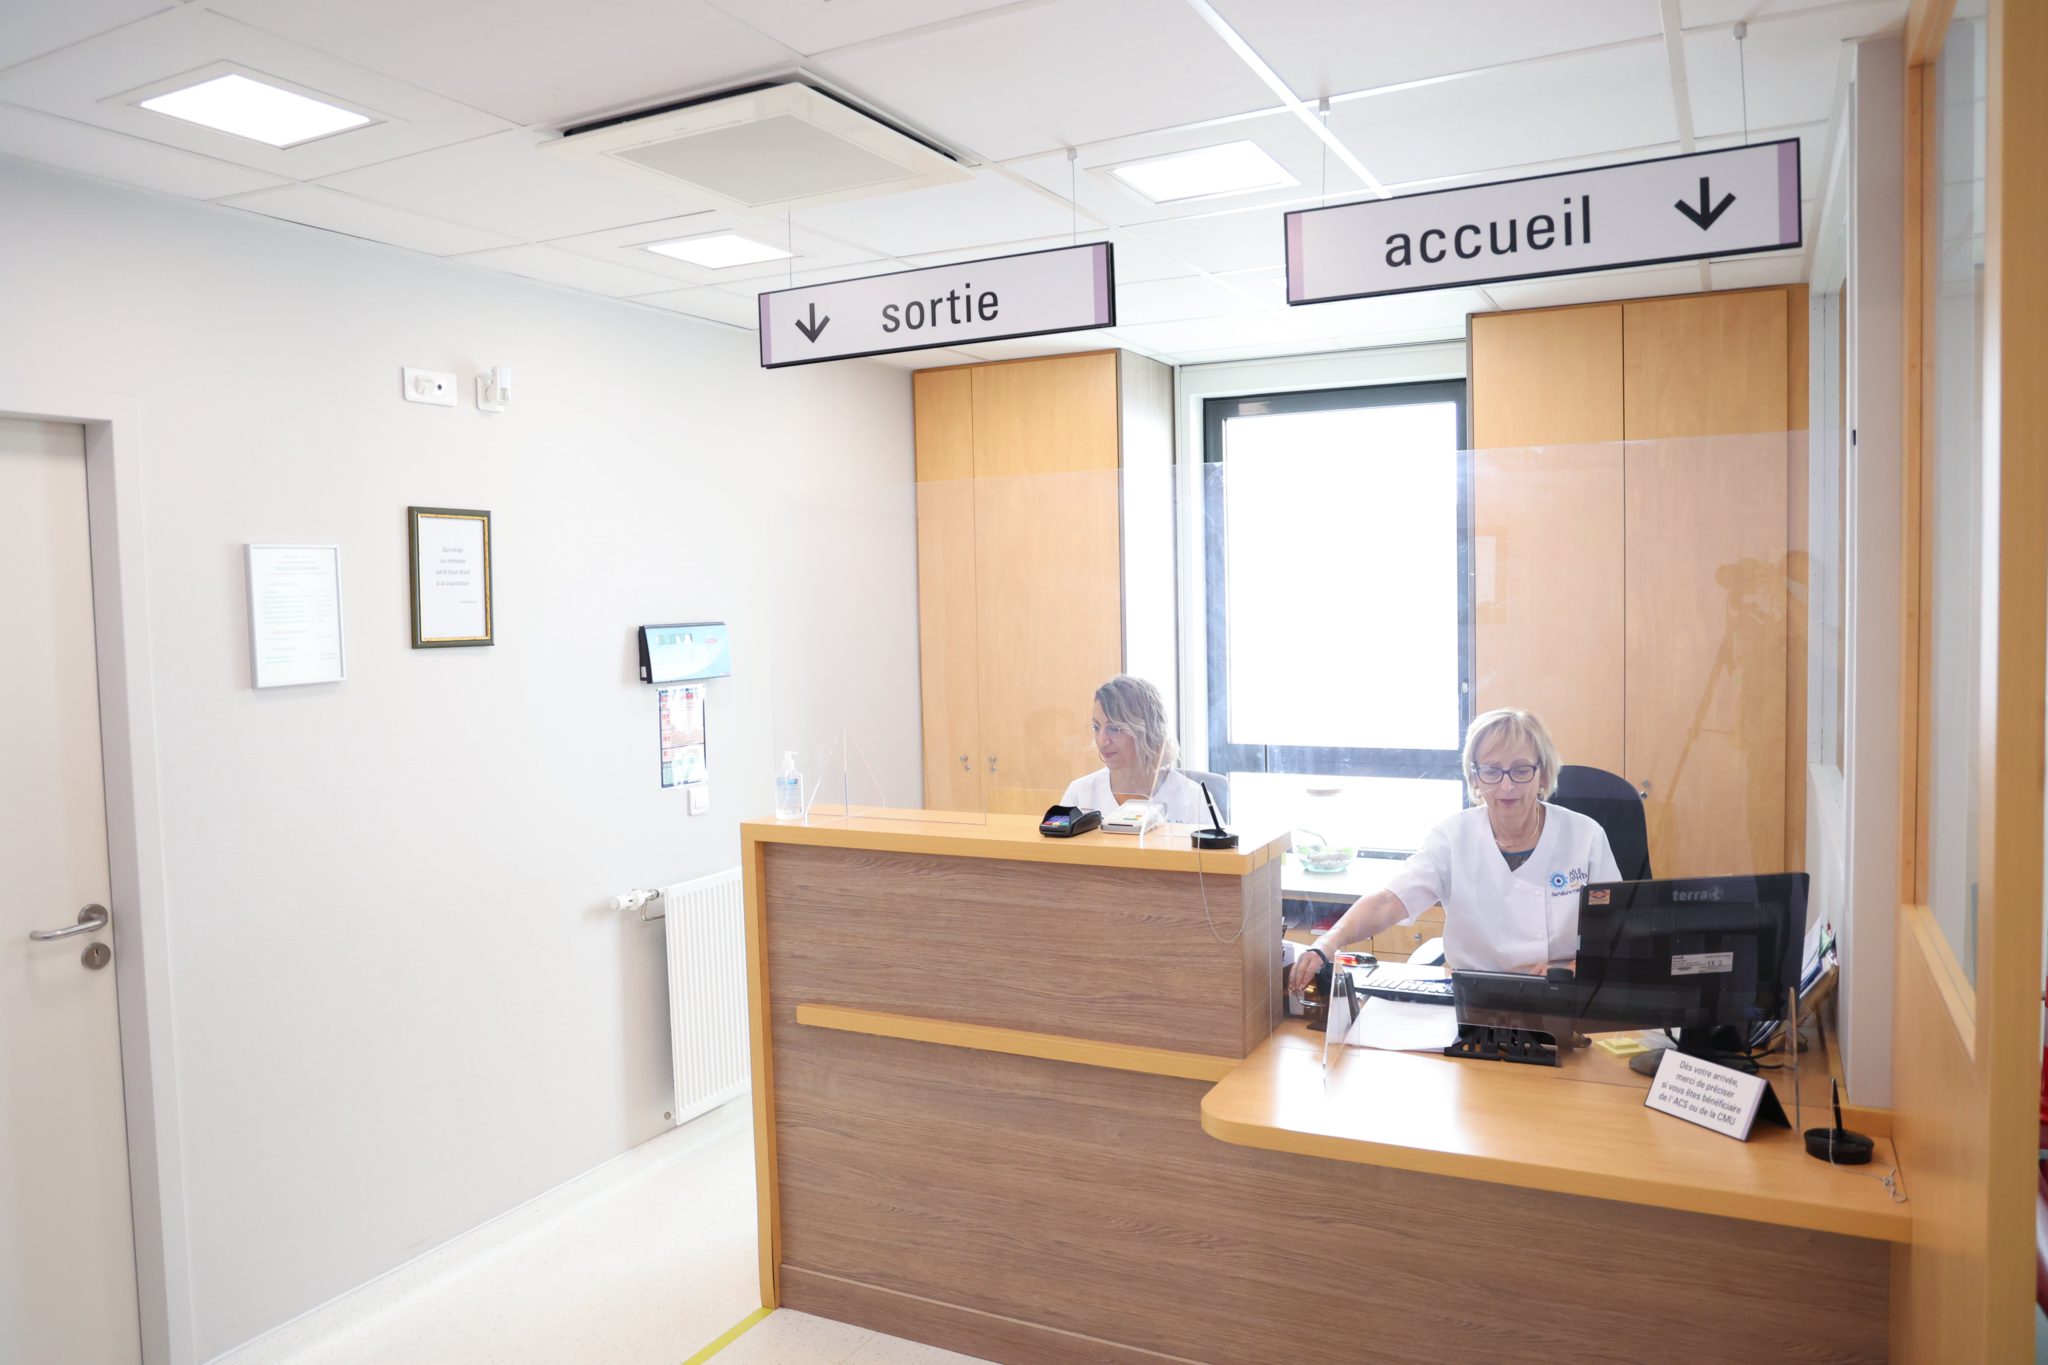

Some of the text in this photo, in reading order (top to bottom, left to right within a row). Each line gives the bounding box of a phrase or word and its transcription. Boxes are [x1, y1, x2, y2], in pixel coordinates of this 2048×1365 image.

[1385, 195, 1591, 267] accueil
[882, 283, 998, 333] sortie
[1672, 890, 1708, 901] terra
[1676, 1073, 1735, 1099] merci de préciser
[1680, 1060, 1738, 1088] Dès votre arrivée,
[1658, 1093, 1668, 1102] de
[1673, 1097, 1689, 1109] ACS
[1688, 1103, 1698, 1112] ou
[1699, 1107, 1708, 1117] de
[1709, 1110, 1716, 1119] la
[1717, 1112, 1737, 1126] CMU
[1661, 1081, 1742, 1114] si vous êtes bénéficiaire
